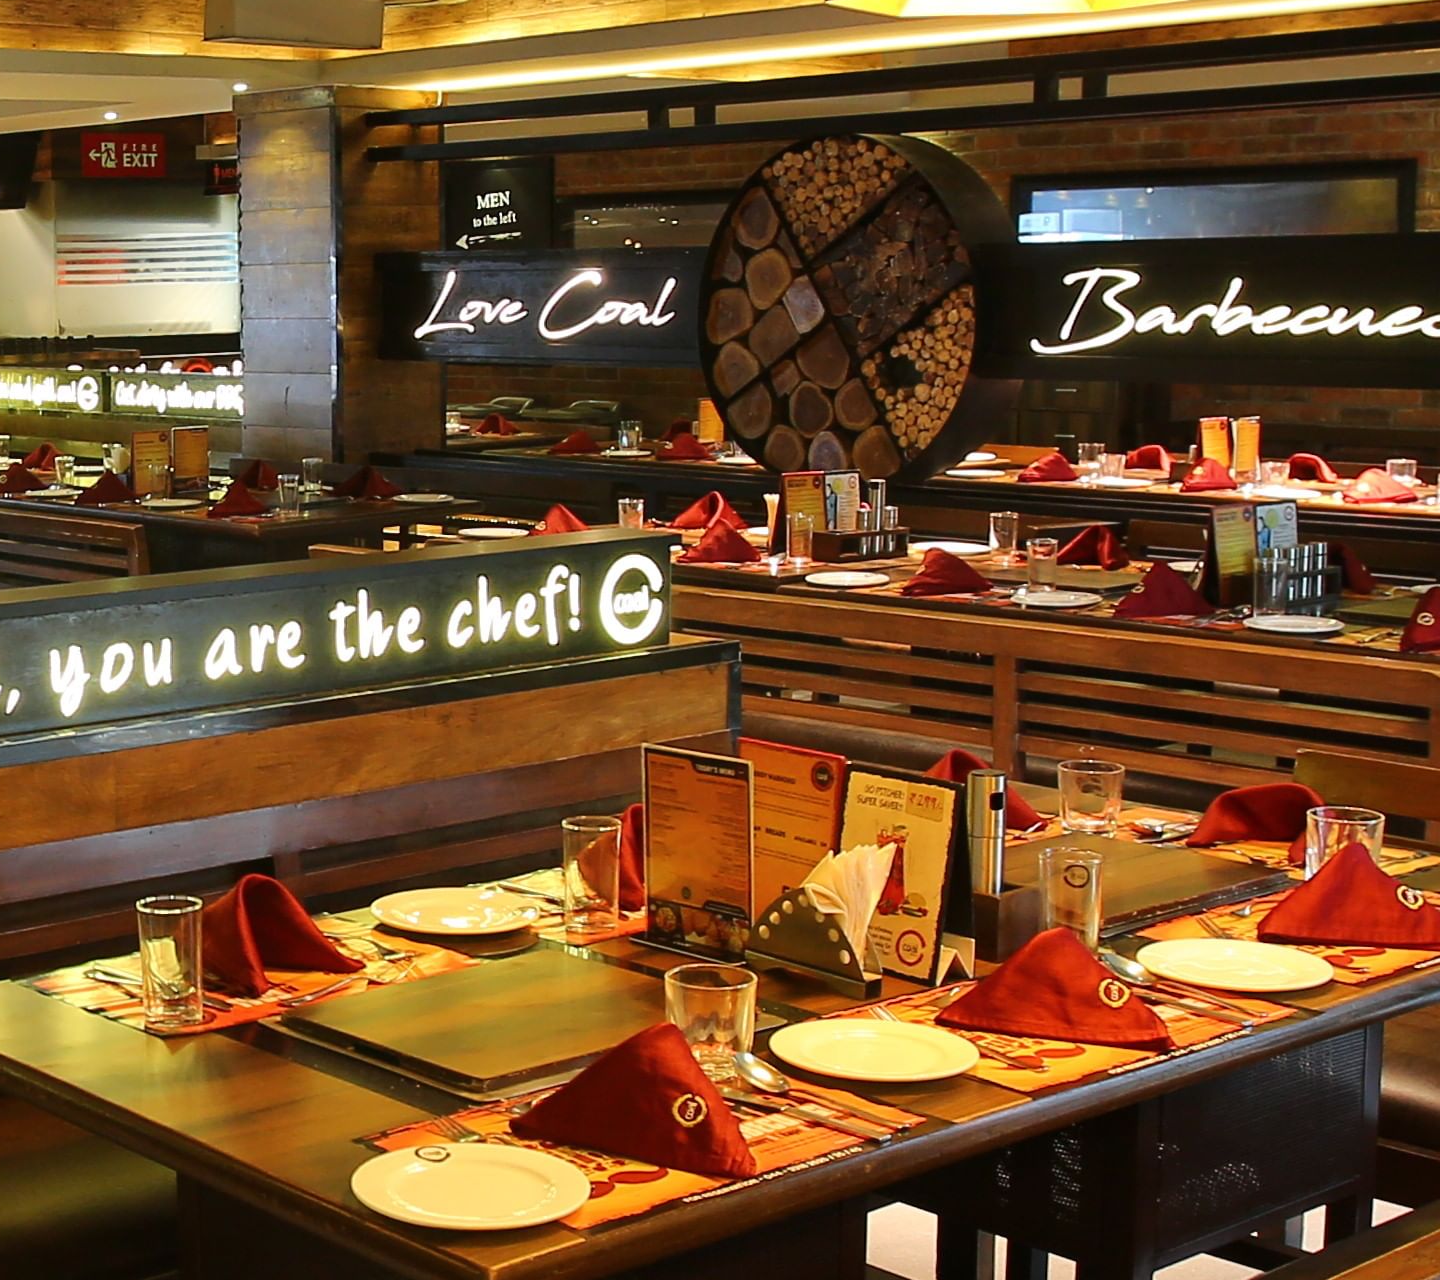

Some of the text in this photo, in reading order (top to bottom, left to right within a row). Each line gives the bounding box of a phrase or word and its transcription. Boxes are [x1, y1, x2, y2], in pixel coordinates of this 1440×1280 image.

[123, 143, 158, 152] FIRE
[123, 153, 158, 168] EXIT
[476, 190, 511, 210] MEN
[472, 210, 517, 228] to the left
[414, 271, 527, 339] Love
[538, 267, 676, 339] Coal
[49, 638, 172, 717] you
[204, 621, 305, 680] are
[329, 589, 424, 662] the
[447, 565, 580, 648] chef!
